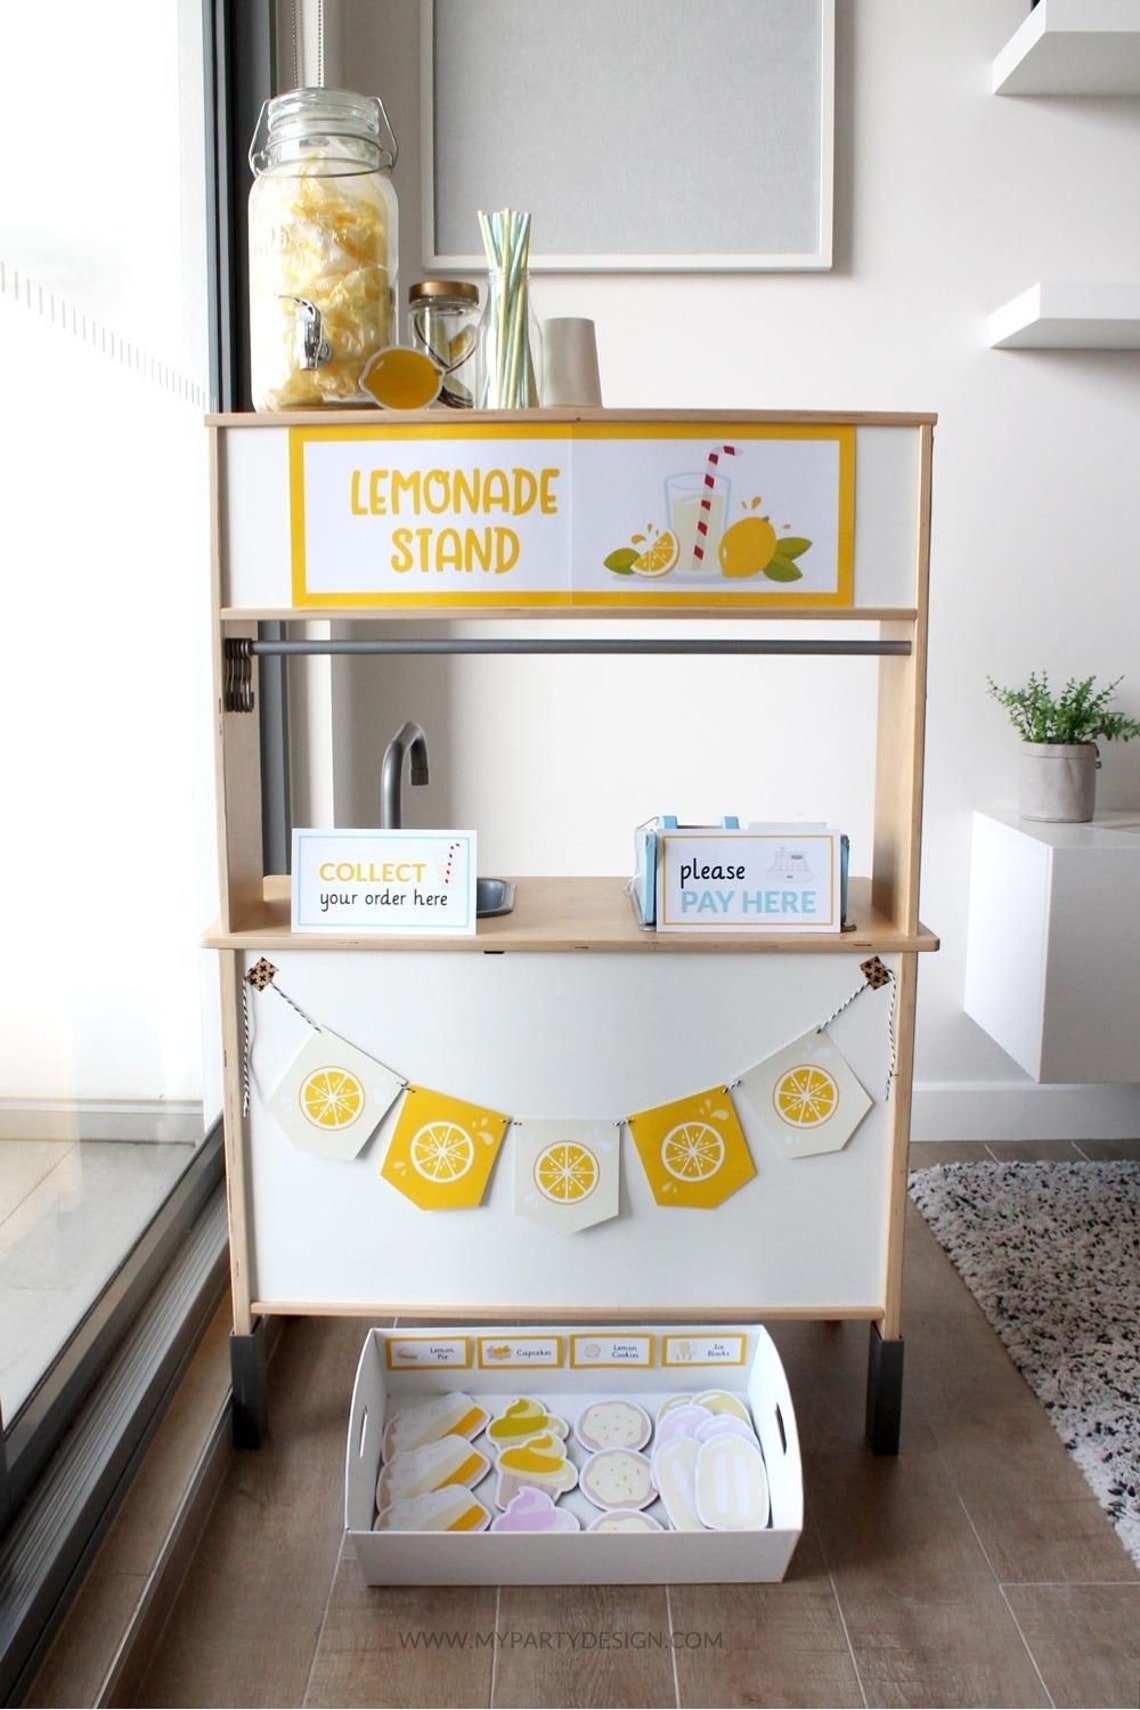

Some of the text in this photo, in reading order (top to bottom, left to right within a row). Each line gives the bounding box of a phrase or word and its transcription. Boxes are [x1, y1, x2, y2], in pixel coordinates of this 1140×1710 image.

[350, 467, 560, 516] LEMONADE
[390, 526, 520, 575] STAND
[319, 862, 426, 882] COLLECT
[680, 857, 746, 889] please
[320, 889, 448, 912] your order here
[681, 890, 817, 914] PAY HERE
[516, 1349, 552, 1357] Cupcakes
